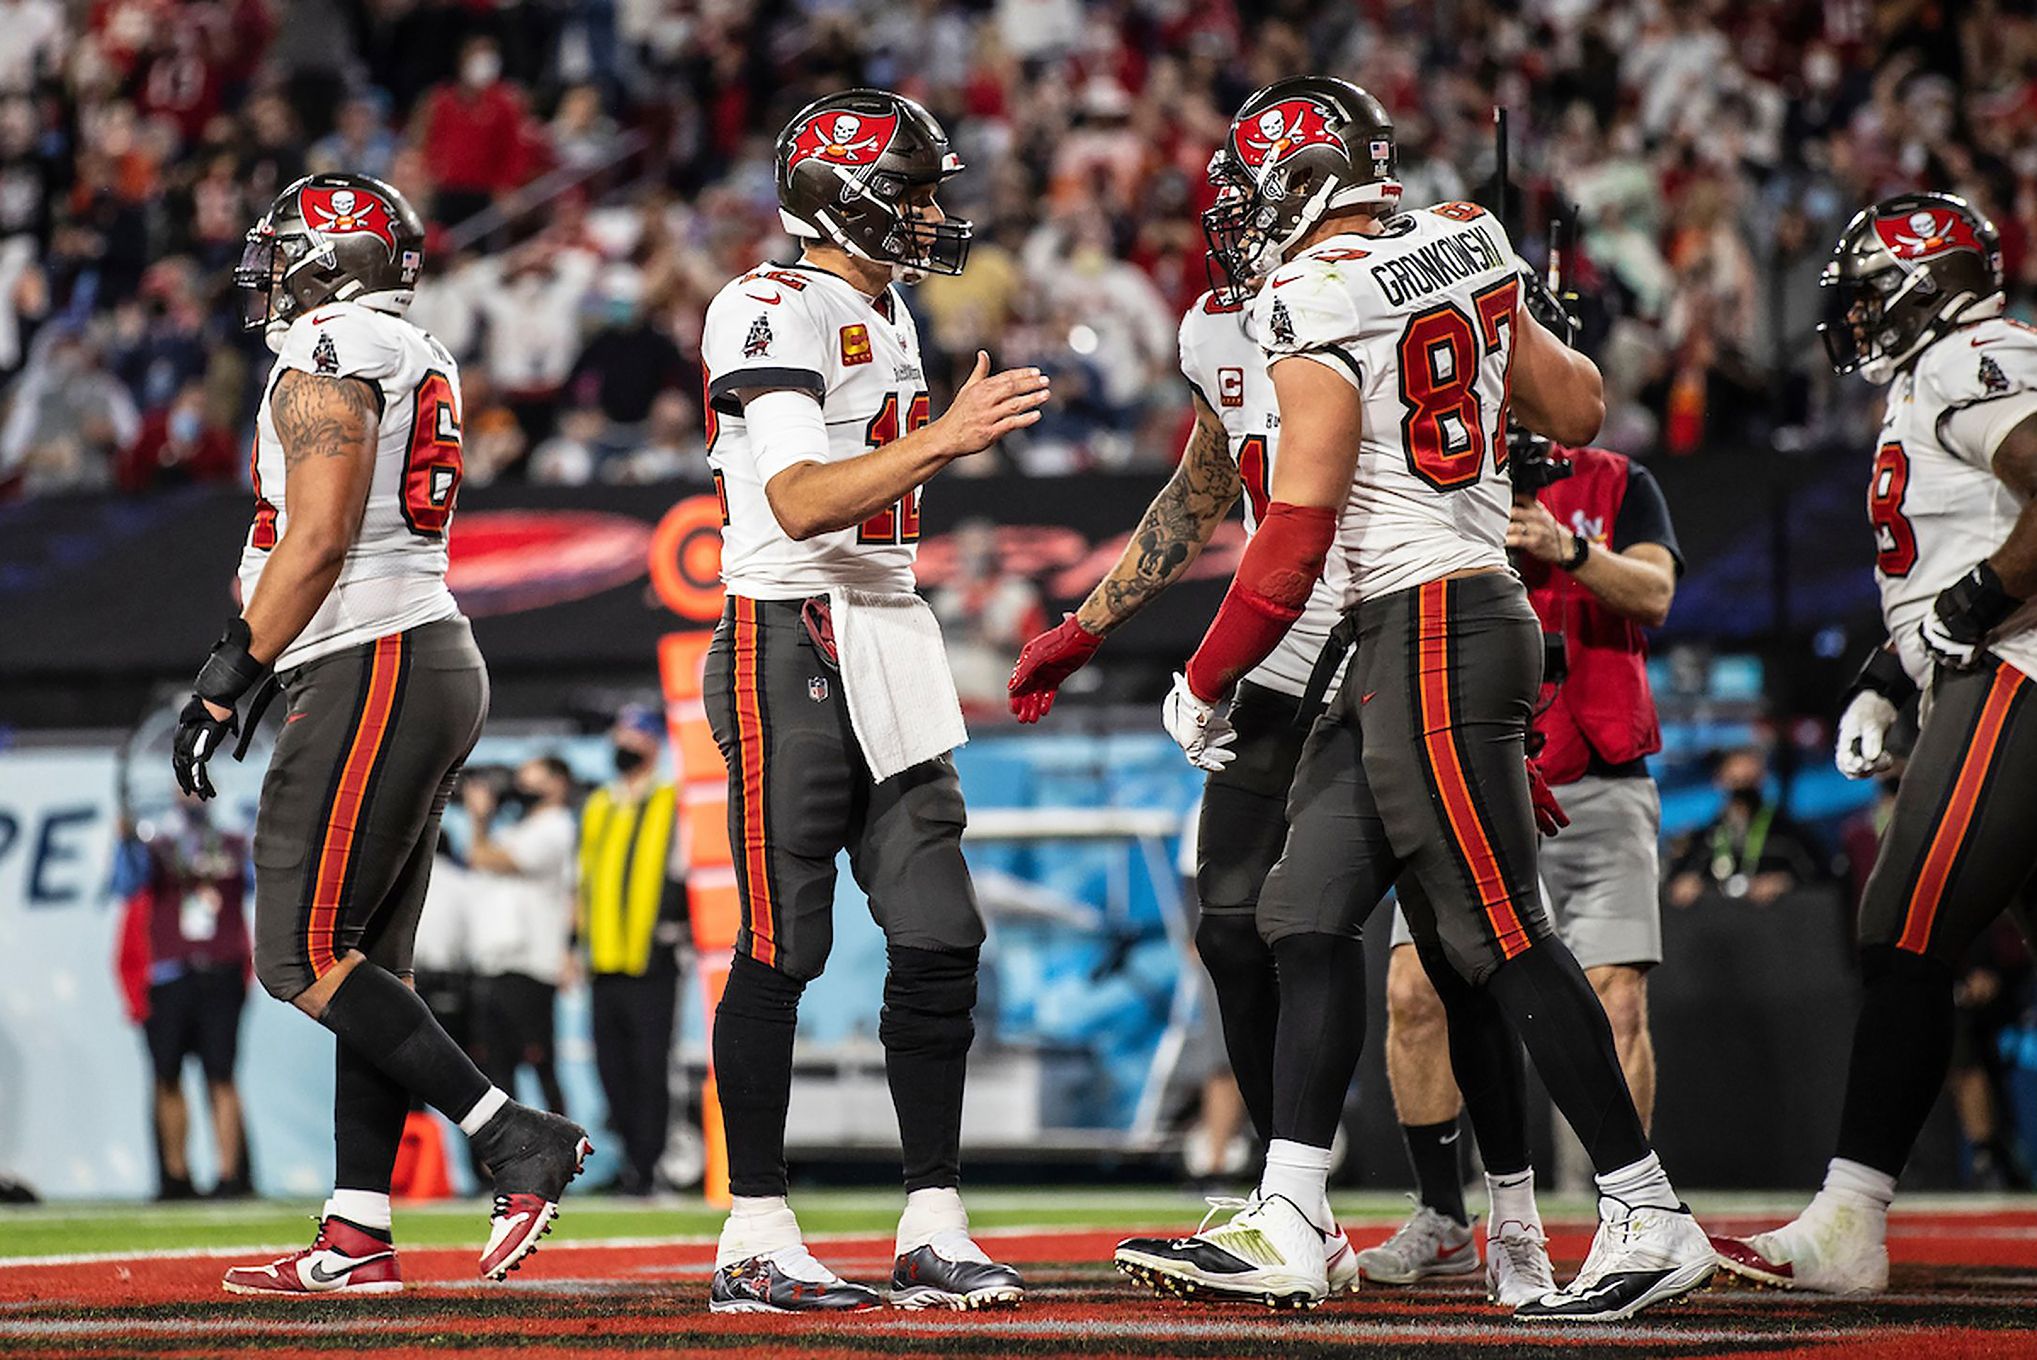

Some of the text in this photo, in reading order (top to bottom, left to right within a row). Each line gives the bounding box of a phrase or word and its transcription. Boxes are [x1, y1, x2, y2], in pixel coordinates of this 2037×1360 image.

[1370, 225, 1503, 306] GRONKOWSKI
[1220, 370, 1241, 397] C
[1397, 271, 1517, 493] 87
